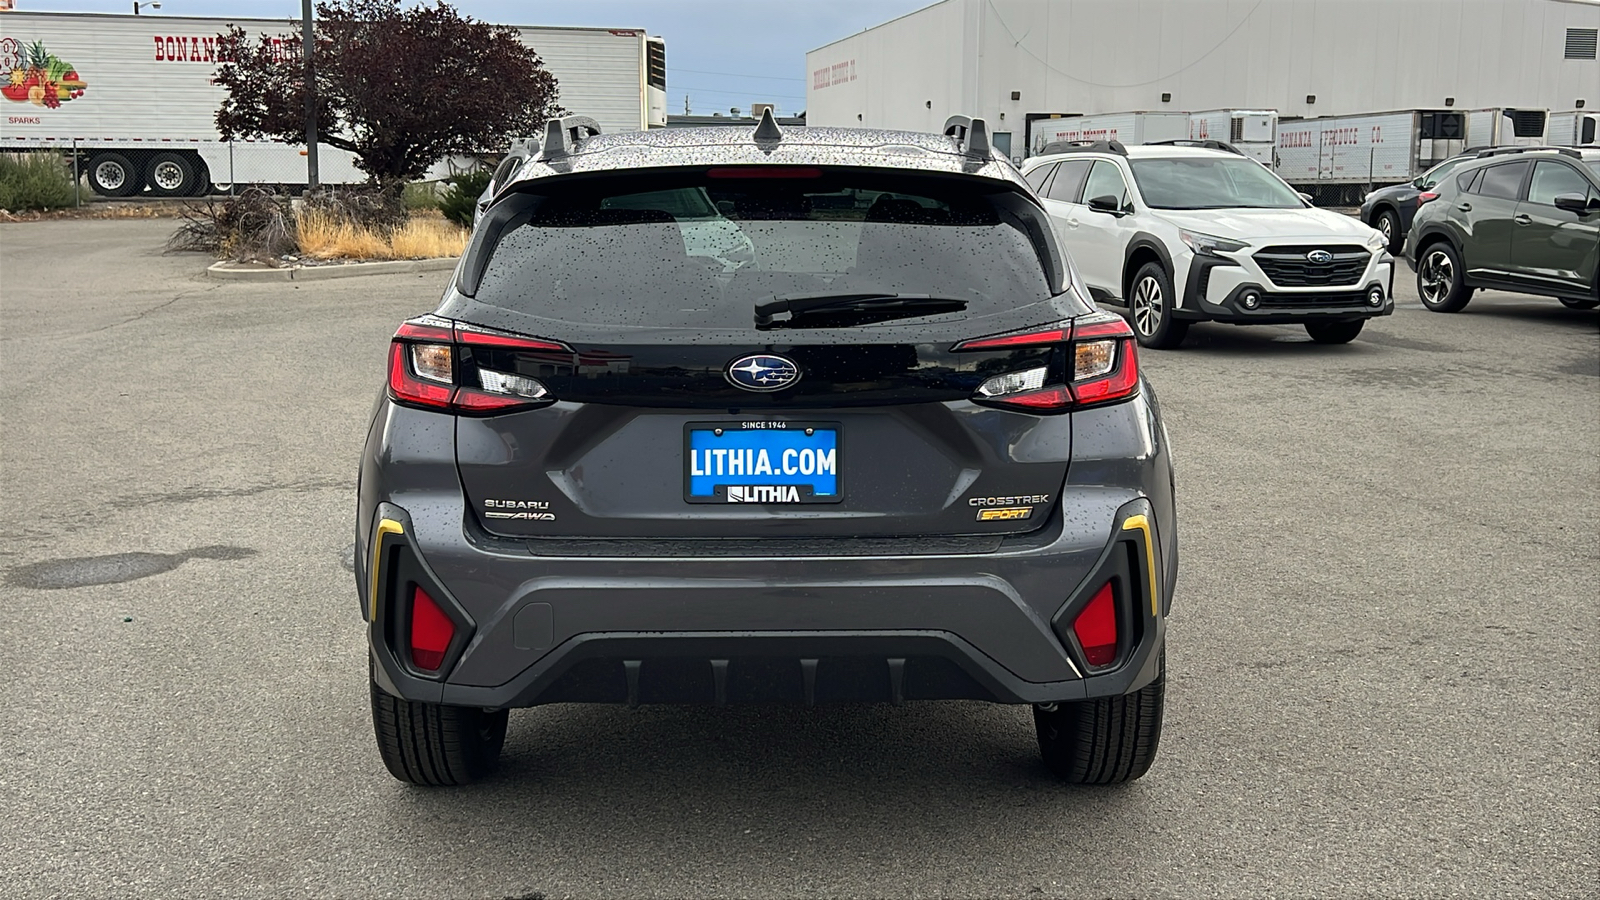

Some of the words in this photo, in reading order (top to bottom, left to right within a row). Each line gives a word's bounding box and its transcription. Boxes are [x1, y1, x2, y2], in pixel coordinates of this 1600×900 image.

[1280, 131, 1312, 148] BONANZA
[1324, 127, 1358, 146] PRODUCE
[1371, 126, 1384, 143] CO.
[741, 421, 766, 429] SINCE
[768, 421, 787, 429] 1946
[690, 448, 837, 476] LITHIA.COM
[744, 486, 801, 503] LITHIA
[968, 494, 1049, 506] CROSSTREK
[484, 499, 549, 510] SUBARU
[510, 512, 556, 521] AWD
[980, 509, 1029, 520] SPORT
